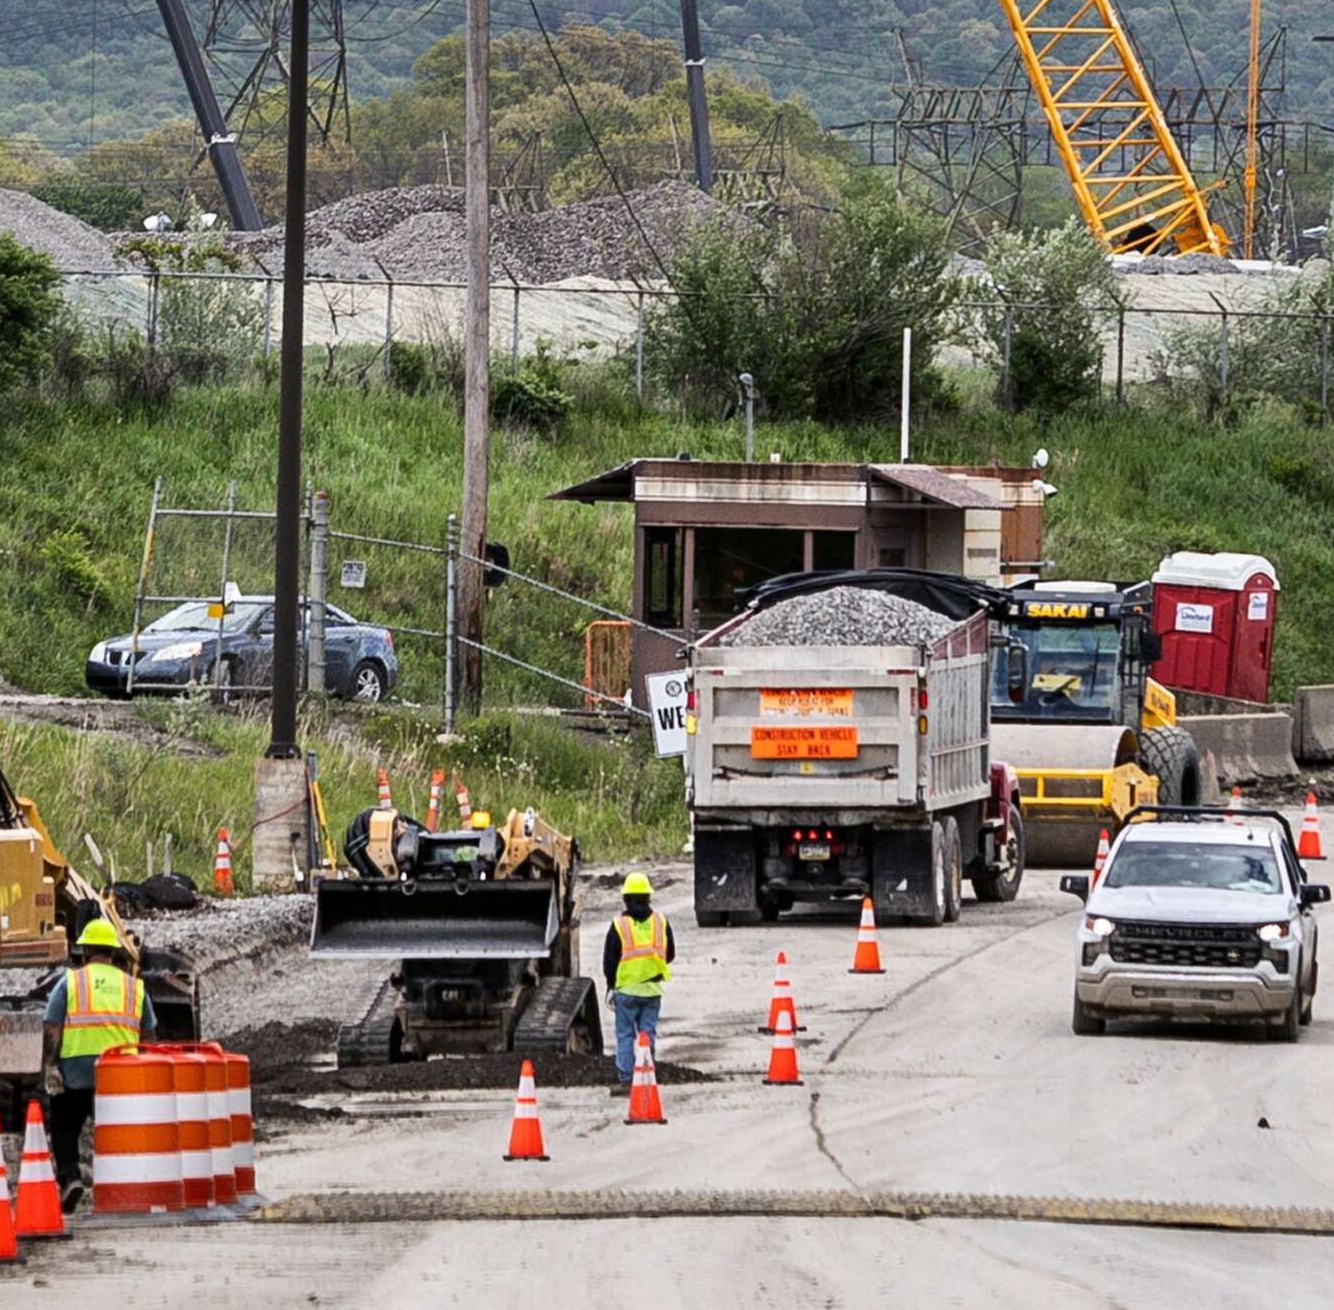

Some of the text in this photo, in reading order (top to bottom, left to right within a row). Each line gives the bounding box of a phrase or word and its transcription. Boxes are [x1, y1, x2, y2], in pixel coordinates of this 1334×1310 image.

[1027, 603, 1087, 618] SAKAI
[754, 727, 852, 740] CONSTRUCTION VEHICLE
[777, 745, 831, 756] STAY BACK
